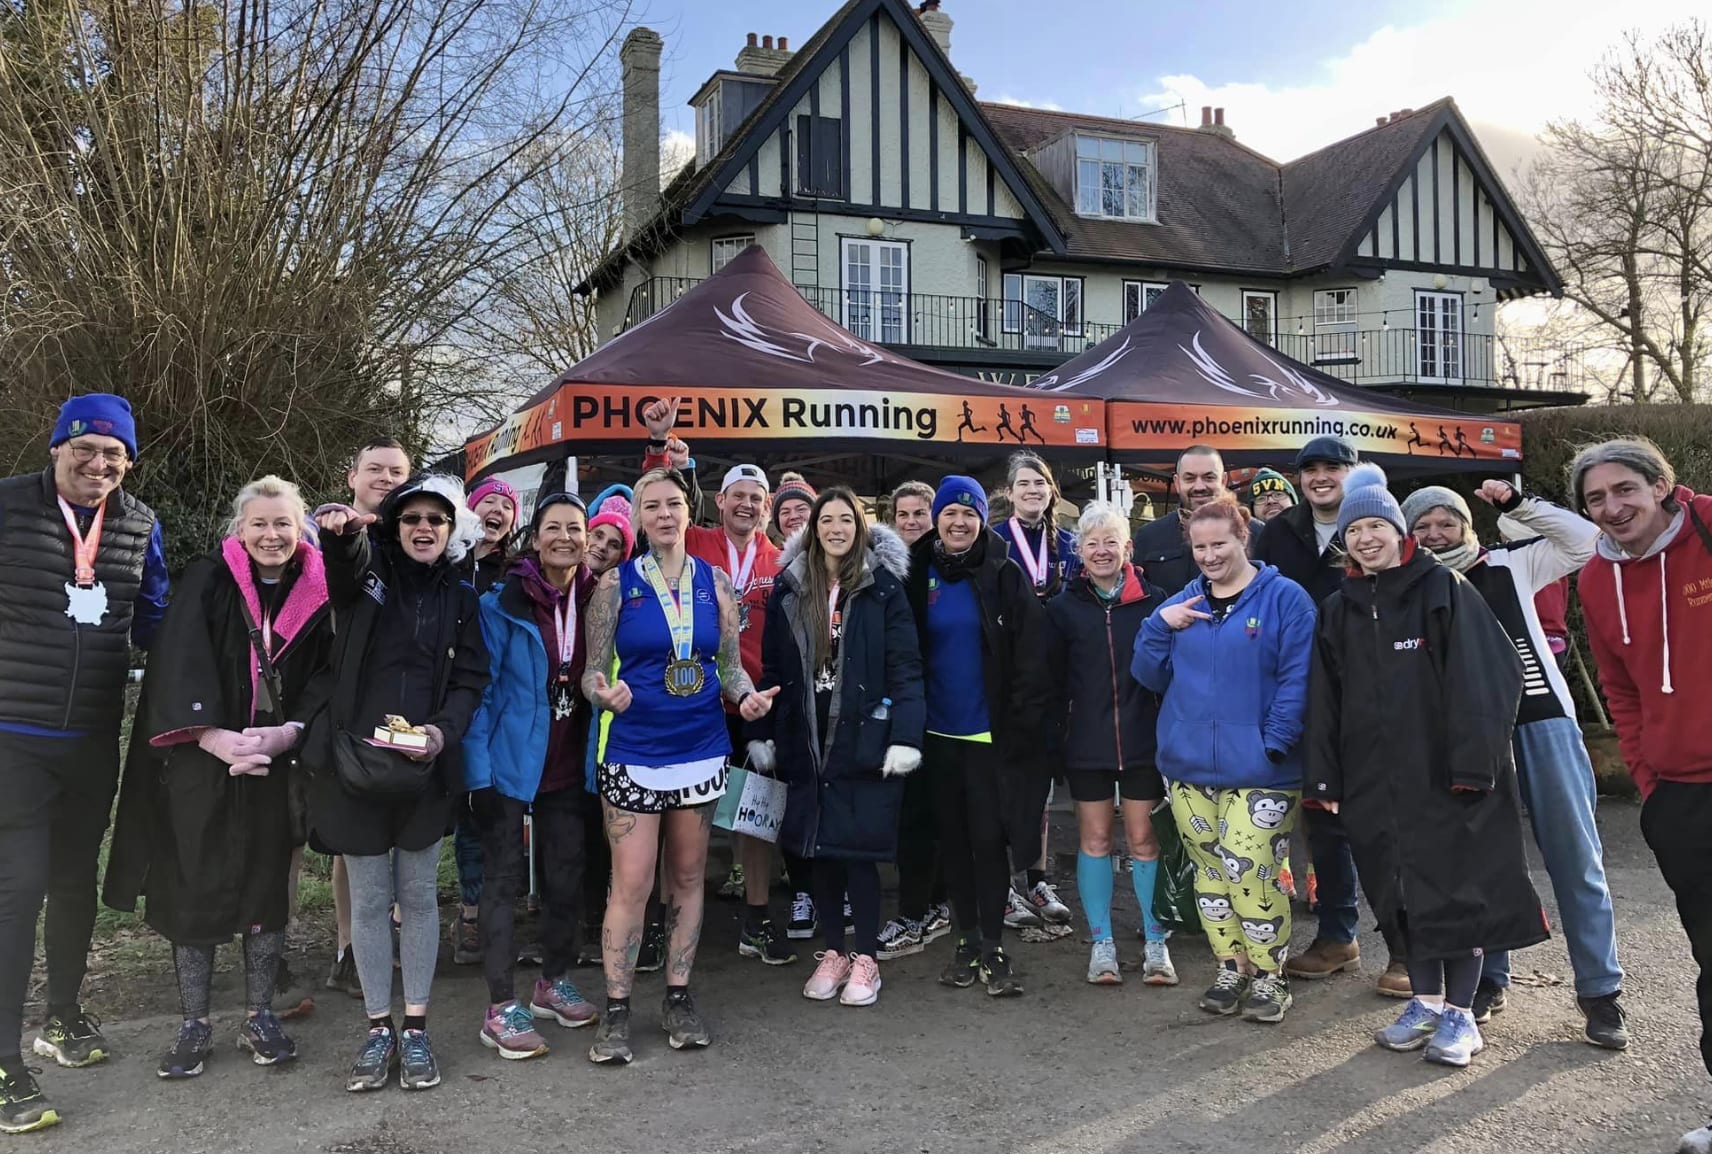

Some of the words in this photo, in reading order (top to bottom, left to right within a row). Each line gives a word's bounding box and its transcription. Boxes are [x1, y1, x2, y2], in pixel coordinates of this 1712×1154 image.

[782, 398, 937, 439] Running
[1132, 416, 1398, 439] www.phoenixrunning.co.uk
[673, 666, 696, 687] 100
[738, 806, 782, 831] HOORAY
